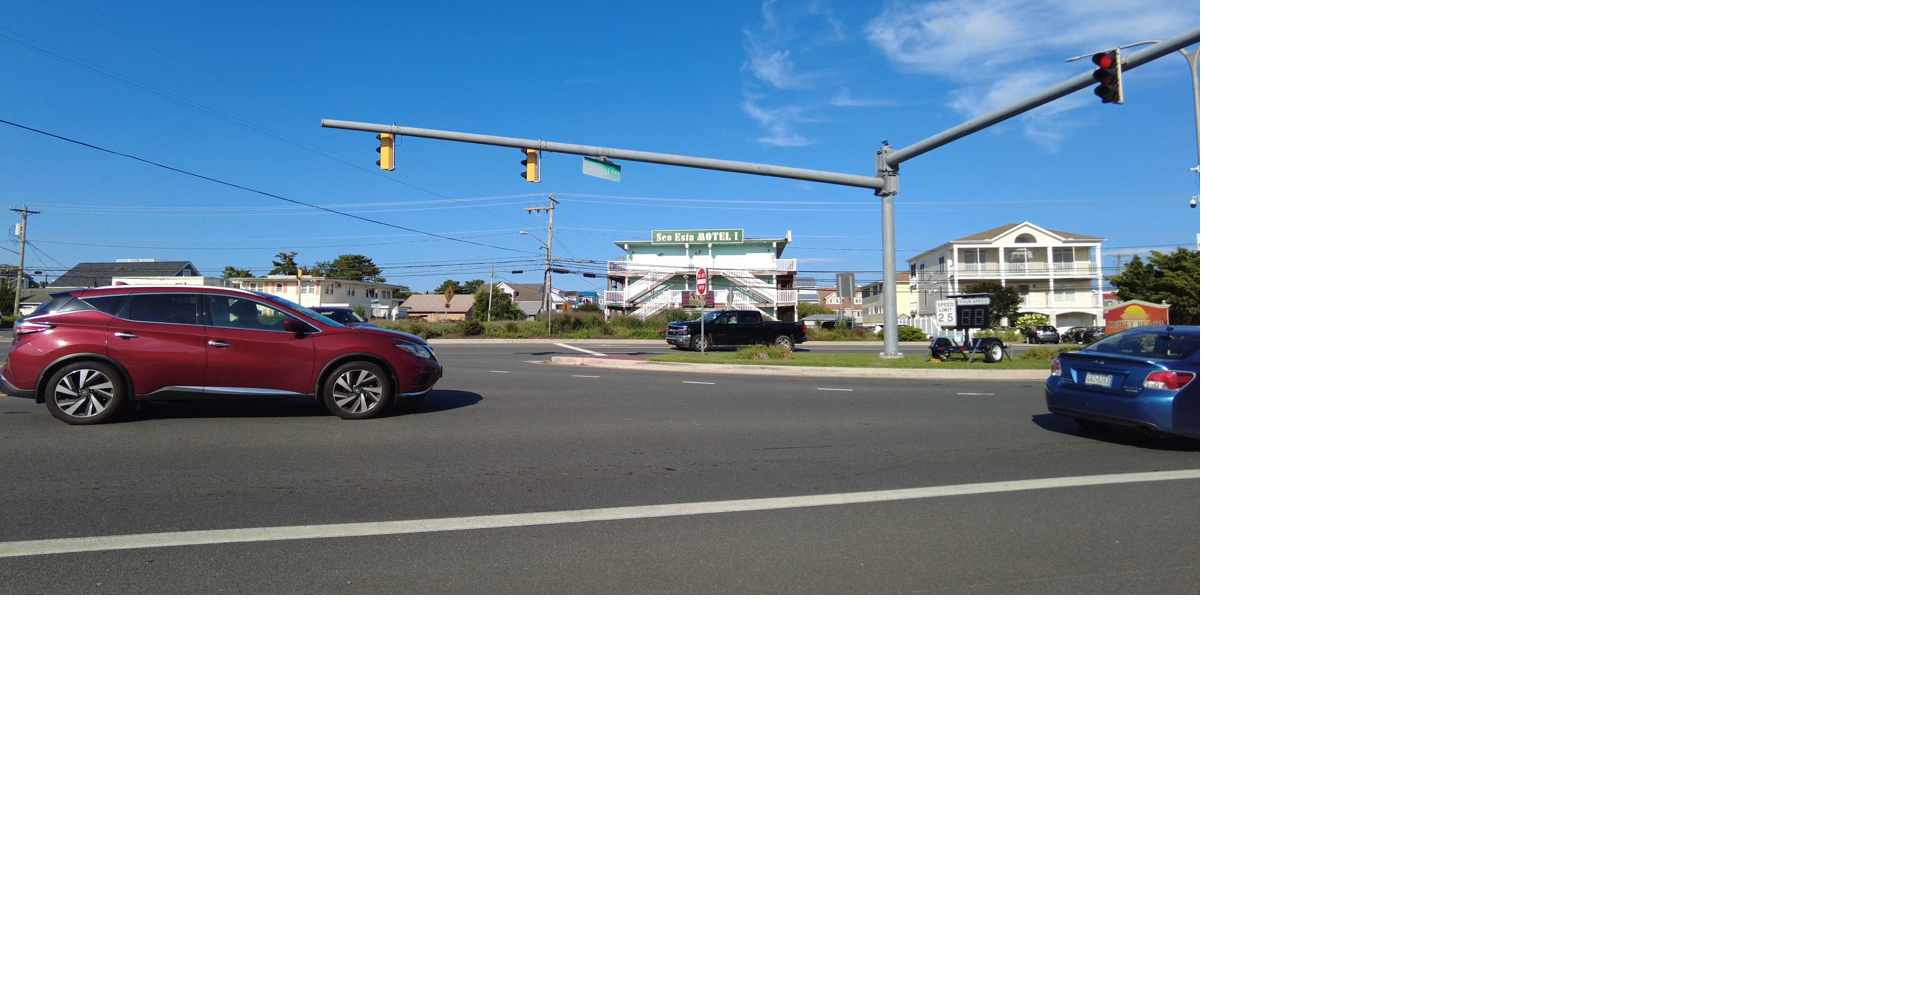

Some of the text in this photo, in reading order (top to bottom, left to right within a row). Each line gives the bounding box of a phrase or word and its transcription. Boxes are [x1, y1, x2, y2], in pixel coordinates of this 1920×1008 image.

[656, 232, 672, 242] Sea
[674, 232, 694, 242] Esta
[697, 231, 731, 241] MOTEL
